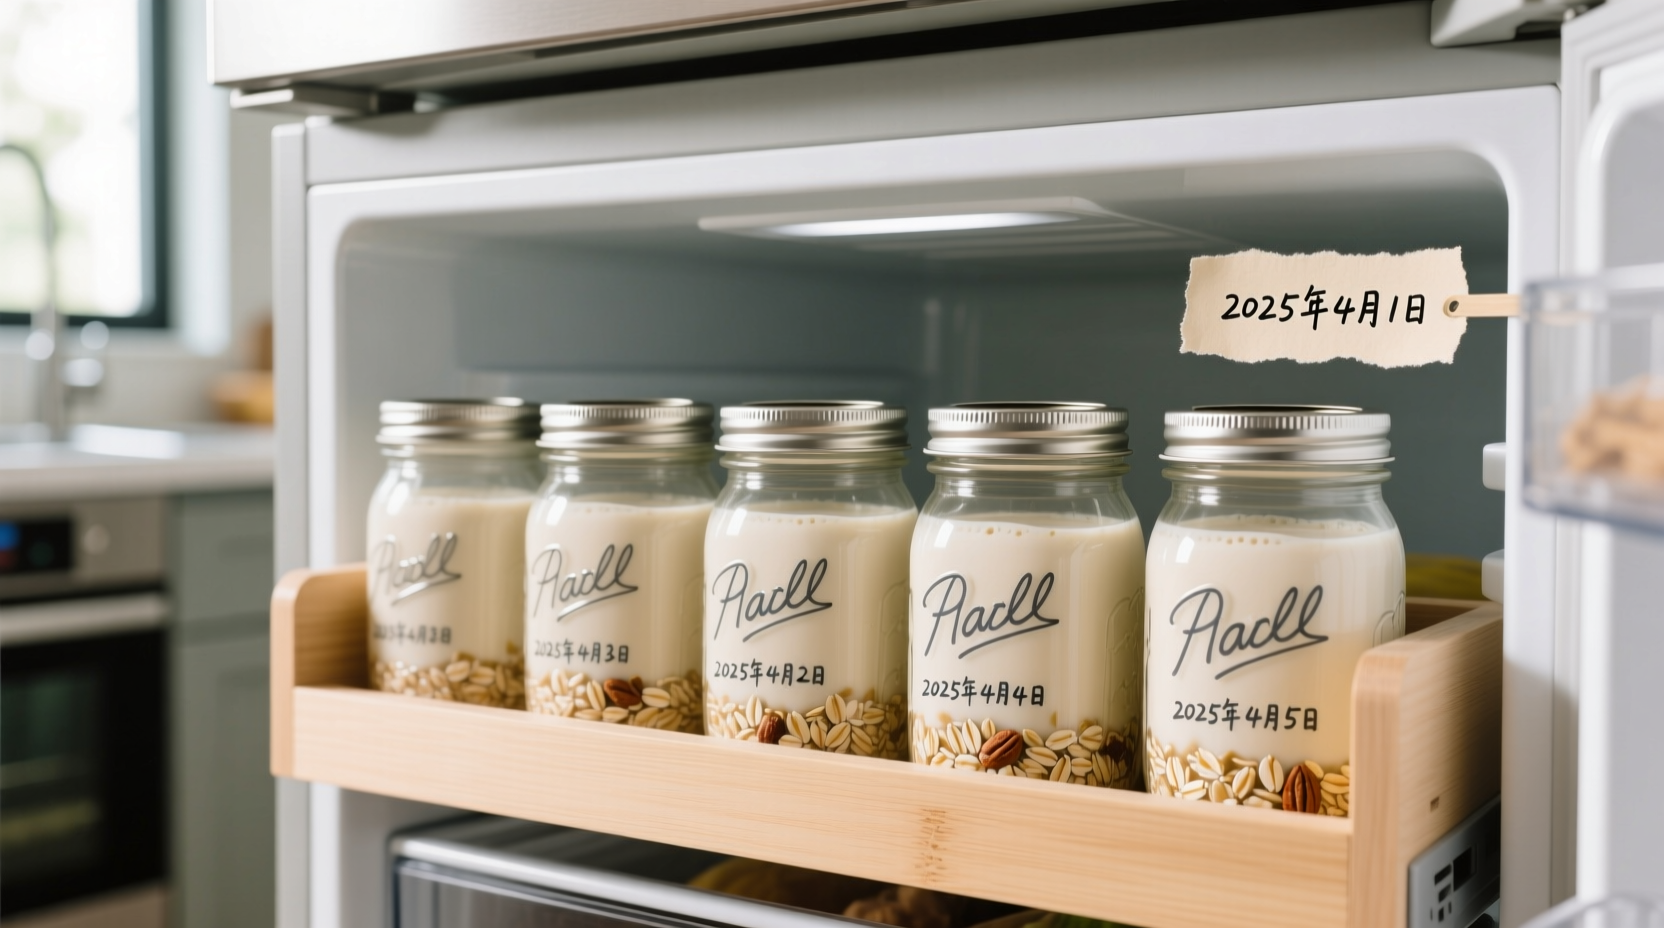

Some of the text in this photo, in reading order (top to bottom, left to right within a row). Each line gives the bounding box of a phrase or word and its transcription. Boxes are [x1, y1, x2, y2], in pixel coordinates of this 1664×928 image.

[1221, 285, 1425, 330] 2025年4月1日
[534, 639, 629, 664] 2025年4月3日
[713, 658, 825, 688] 2025年4月2日
[922, 676, 1045, 707] 2025年4月4日
[1172, 698, 1318, 732] 2025年4月5日
